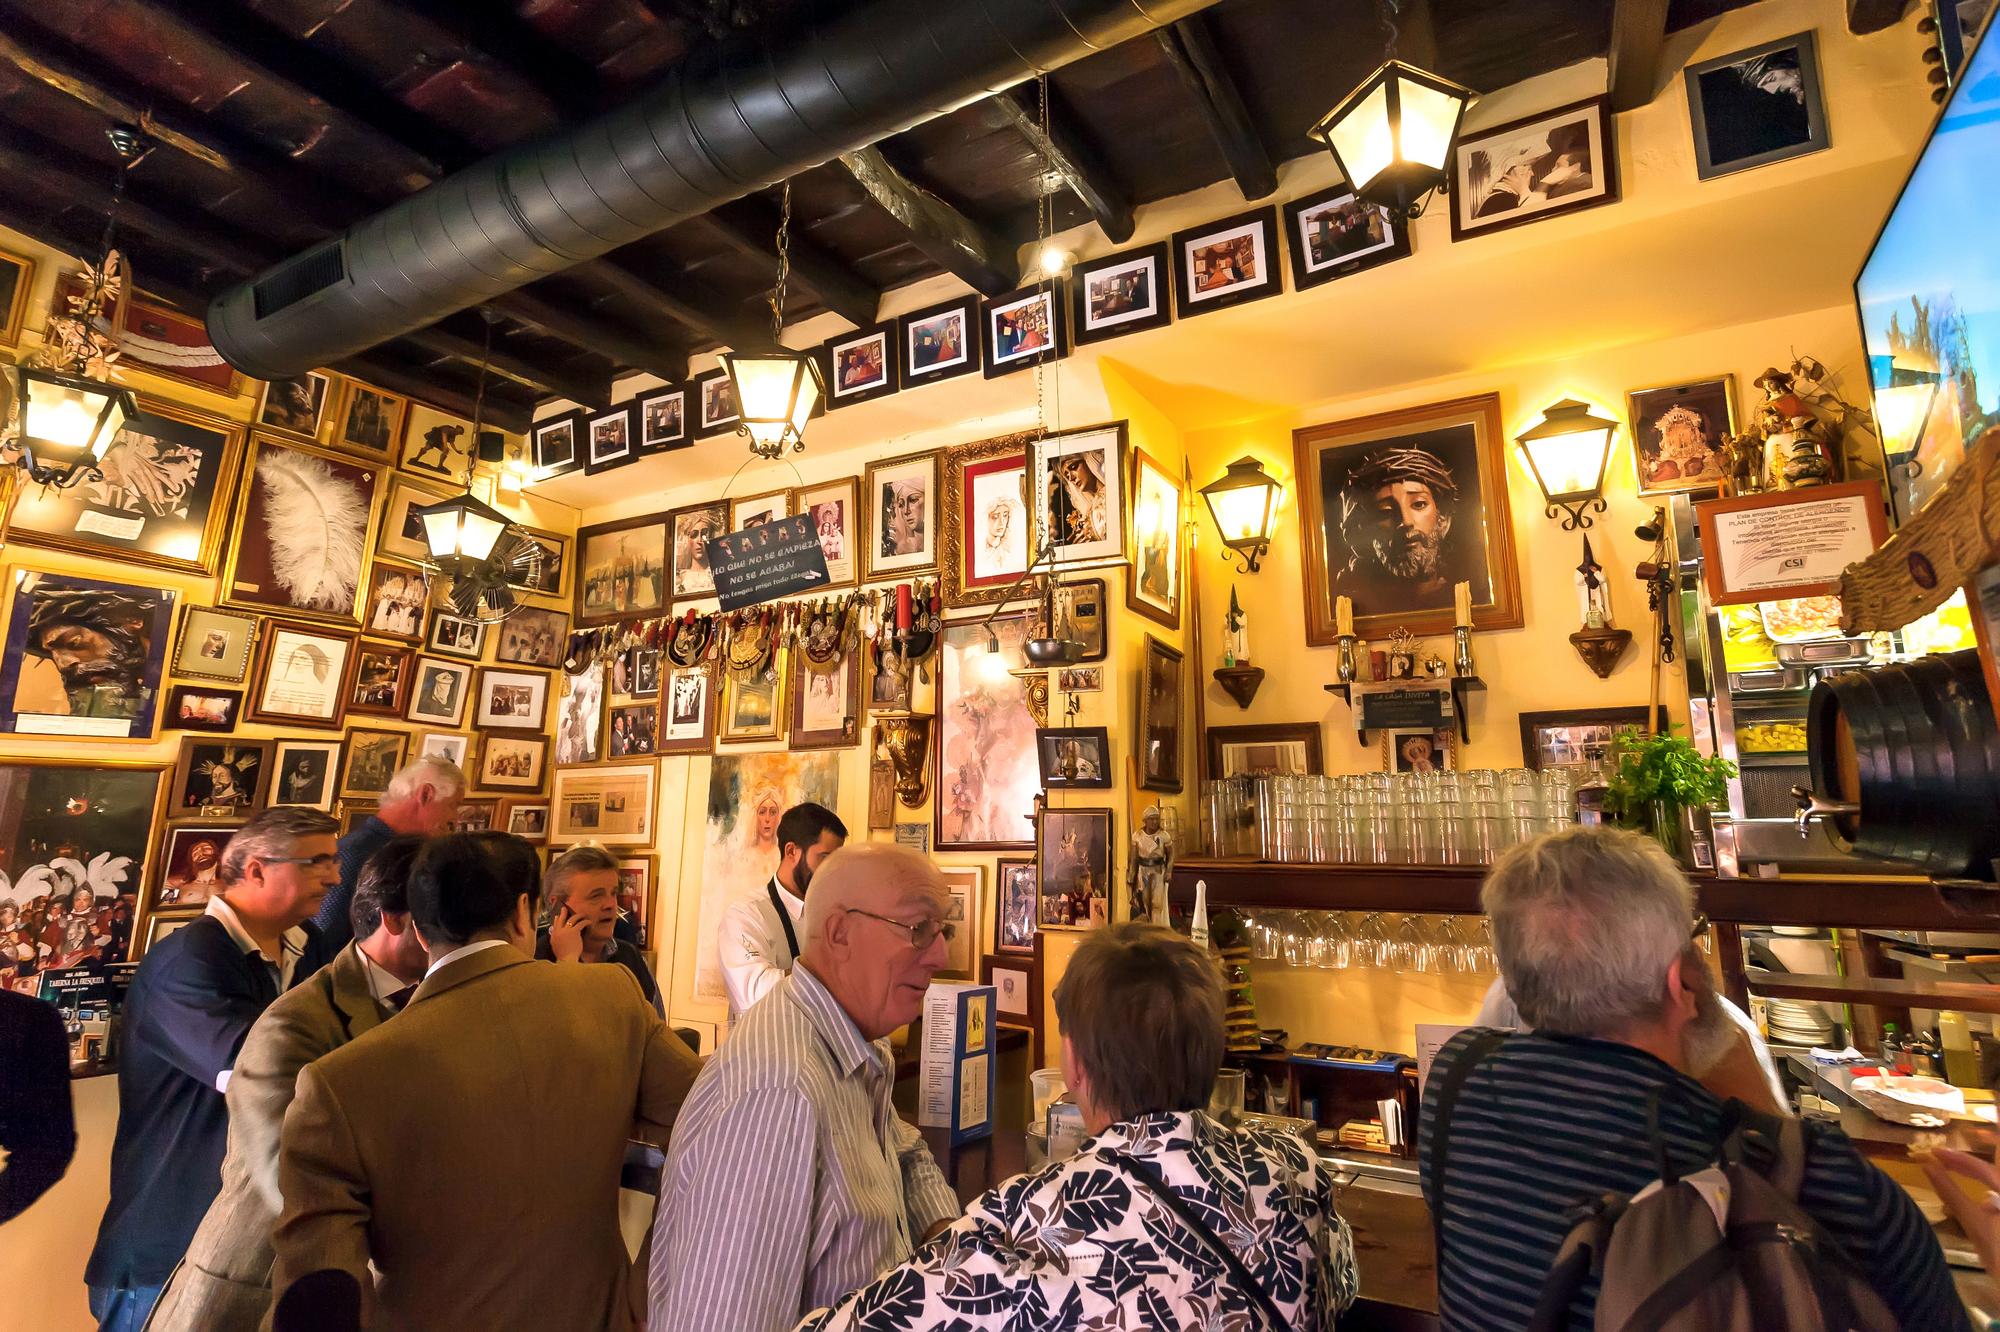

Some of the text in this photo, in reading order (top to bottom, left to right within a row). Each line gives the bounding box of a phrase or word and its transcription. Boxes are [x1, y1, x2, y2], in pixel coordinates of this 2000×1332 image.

[727, 559, 746, 571] QUE
[748, 555, 763, 566] NO
[764, 552, 776, 561] SE
[777, 539, 821, 558] EMPIEZA
[1784, 557, 1803, 569] CSI
[729, 575, 743, 585] NO
[745, 572, 757, 581] SE
